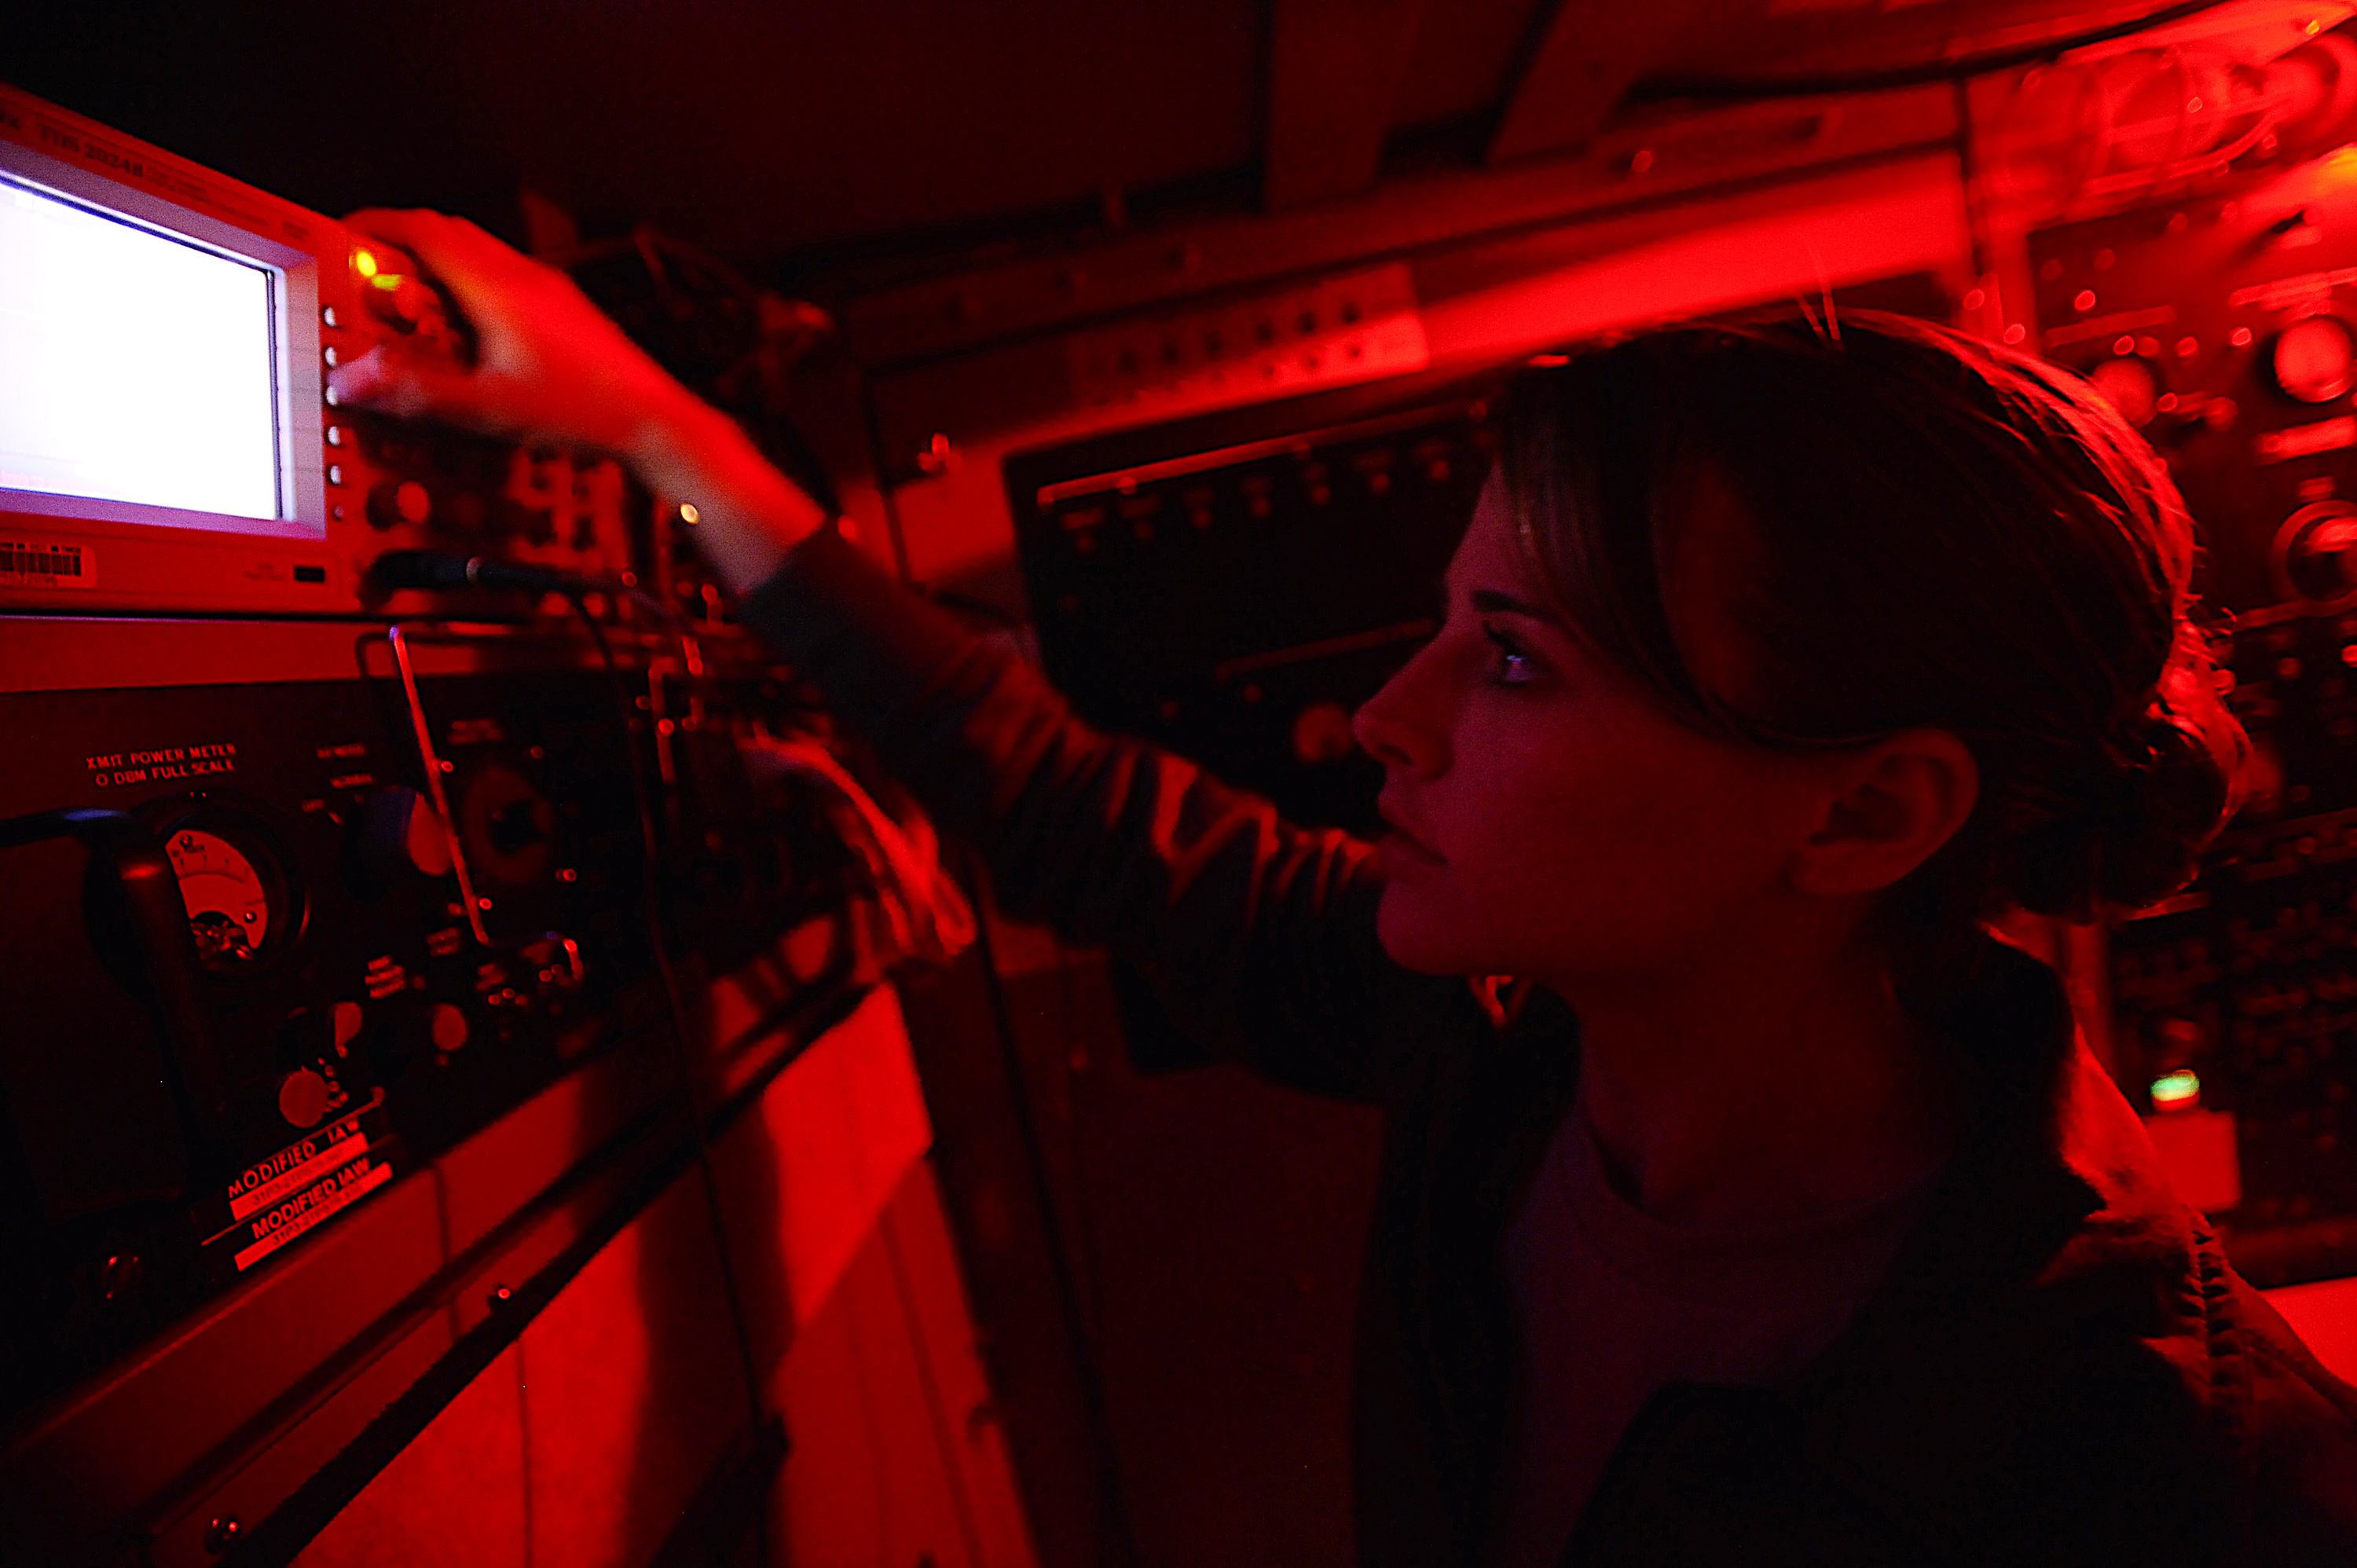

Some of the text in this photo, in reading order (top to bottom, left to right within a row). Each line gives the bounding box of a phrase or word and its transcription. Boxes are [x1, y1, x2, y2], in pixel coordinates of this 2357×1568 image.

[86, 742, 236, 771] XMIT POWER METER
[113, 768, 148, 786] DBM
[151, 764, 189, 780] FULL
[191, 757, 236, 775] SCALE
[227, 1140, 317, 1199] MODIFIED
[251, 1177, 338, 1240] MODIFIED
